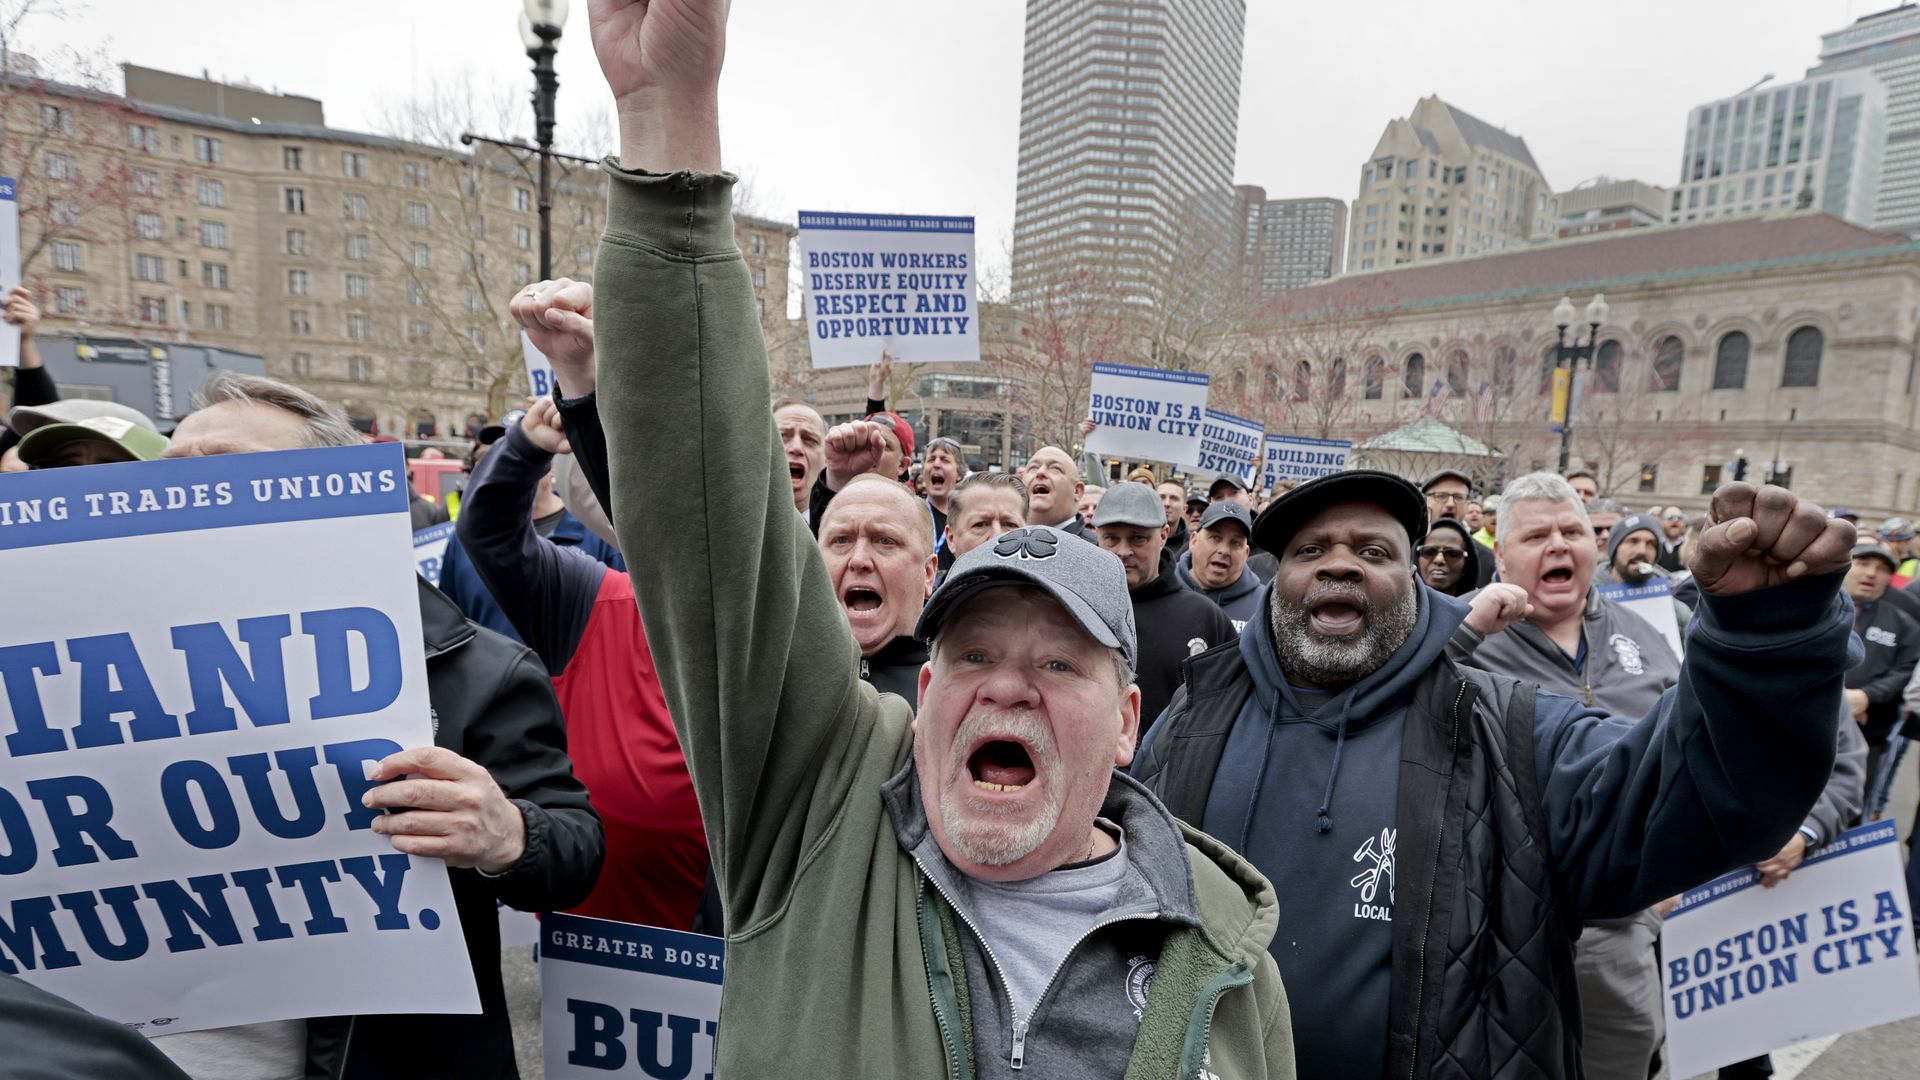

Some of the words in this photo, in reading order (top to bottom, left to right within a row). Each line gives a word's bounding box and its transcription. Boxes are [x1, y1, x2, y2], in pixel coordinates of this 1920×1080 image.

[809, 252, 874, 268] BOSTON
[880, 252, 968, 269] WORKERS
[811, 273, 891, 290] DESERVE
[897, 273, 968, 291] EQUITY
[815, 294, 907, 315] RESPECT
[915, 294, 967, 313] AND
[816, 316, 970, 339] OPPORTUNITY
[1091, 394, 1160, 416] BOSTON
[1165, 402, 1183, 418] IS
[1188, 405, 1202, 420] A
[1091, 411, 1152, 431] UNION
[1157, 419, 1200, 438] CITY
[1266, 463, 1274, 473] A
[1267, 448, 1345, 466] BUILDING
[0, 496, 68, 526] ING
[85, 482, 233, 518] TRADES
[251, 469, 396, 503] UNIONS
[0, 606, 403, 757] TAND
[1849, 827, 1895, 848] UNIONS
[0, 853, 442, 975] MUNITY.
[1354, 903, 1392, 921] LOCAL
[551, 930, 654, 960] GREATER
[664, 947, 725, 971] BOST
[1667, 913, 1808, 989] BOSTON
[1821, 900, 1859, 938] IS
[1874, 890, 1903, 925] A
[1671, 952, 1799, 1020] UNION
[1812, 926, 1904, 975] CITY
